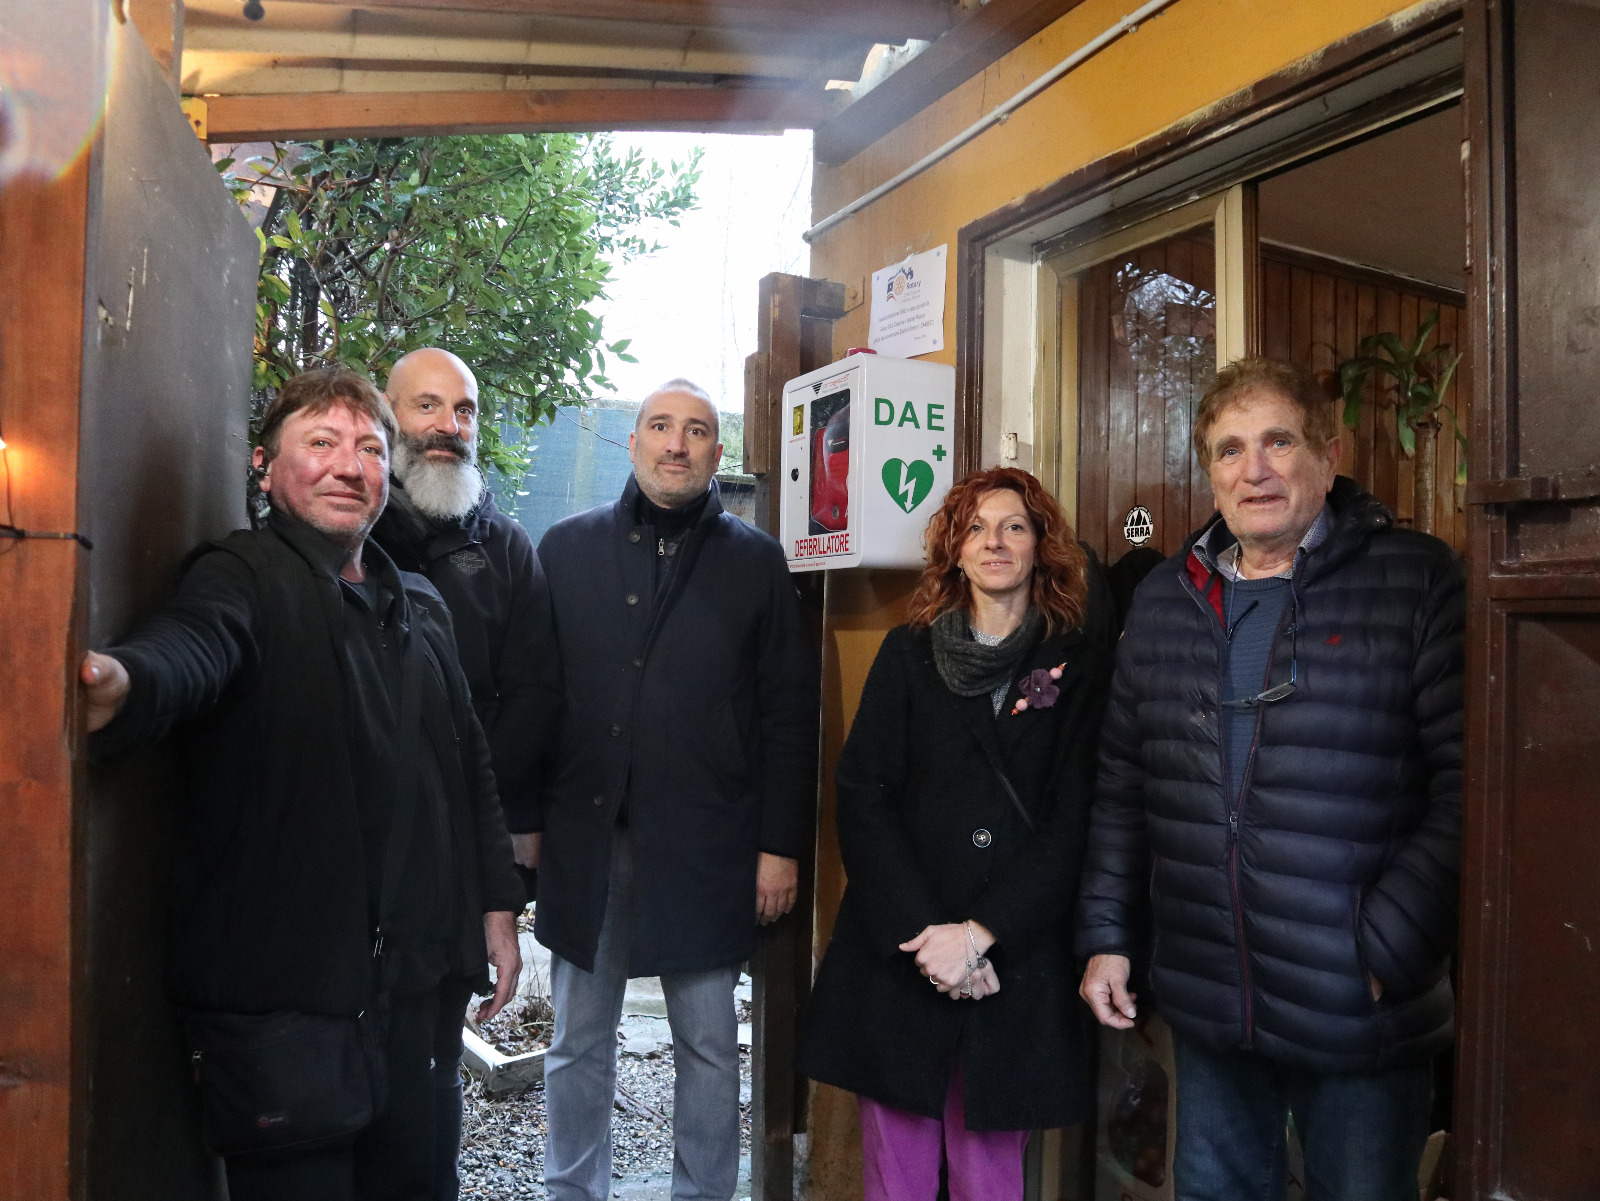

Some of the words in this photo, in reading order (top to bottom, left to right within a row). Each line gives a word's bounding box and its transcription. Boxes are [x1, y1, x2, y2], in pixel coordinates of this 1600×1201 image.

[906, 281, 921, 289] Rotary
[874, 397, 945, 431] DAE
[1126, 526, 1151, 538] SERRA
[795, 533, 849, 557] DEFIBRILLATORE
